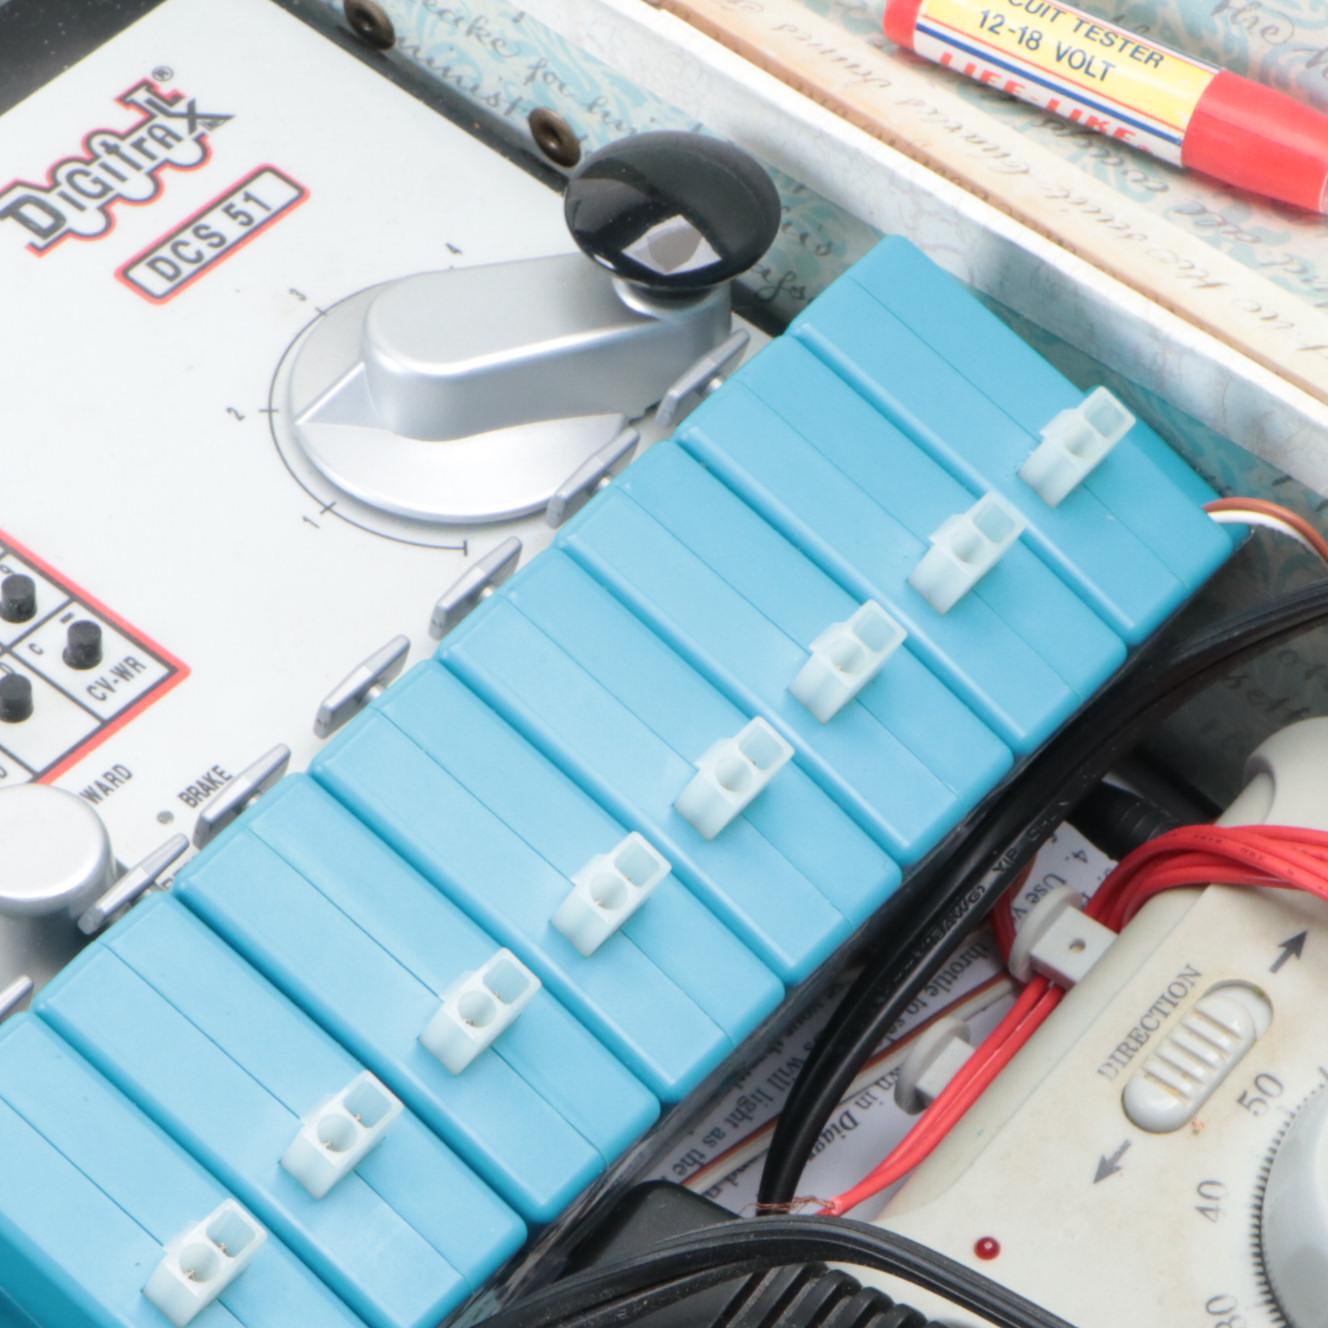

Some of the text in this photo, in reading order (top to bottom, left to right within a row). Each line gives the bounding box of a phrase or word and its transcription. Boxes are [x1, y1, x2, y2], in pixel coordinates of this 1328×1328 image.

[975, 9, 1118, 84] 12-18 VOLT
[1071, 18, 1165, 71] TESTER
[145, 190, 273, 283] DCS 51
[225, 405, 246, 422] 2
[302, 515, 321, 530] 1
[86, 654, 149, 704] CV-WR
[176, 763, 234, 810] BRAKE
[923, 936, 990, 1006] throttle
[1096, 962, 1204, 1083] DIRECTION
[719, 1081, 771, 1134] light
[1235, 1071, 1285, 1117] 50
[699, 1123, 726, 1151] as
[1194, 1178, 1227, 1224] 40
